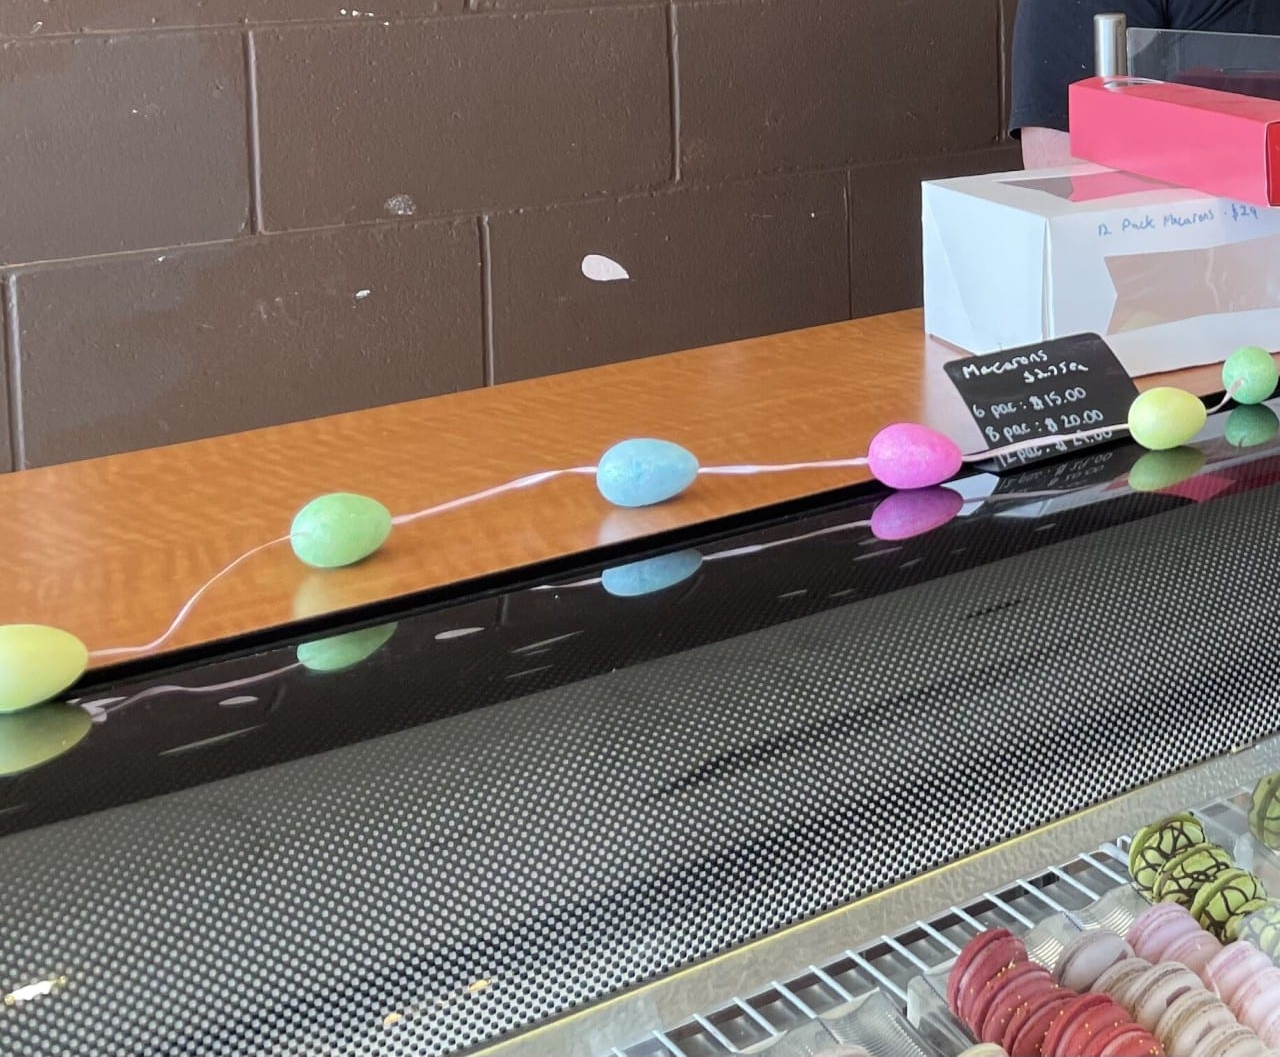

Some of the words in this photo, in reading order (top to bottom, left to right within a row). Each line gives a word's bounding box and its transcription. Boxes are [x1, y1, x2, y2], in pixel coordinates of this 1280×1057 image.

[1121, 213, 1155, 232] Pack
[1162, 207, 1215, 228] Macarons
[961, 348, 1049, 380] Macarons
[972, 402, 986, 419] 6
[984, 425, 1001, 443] 8
